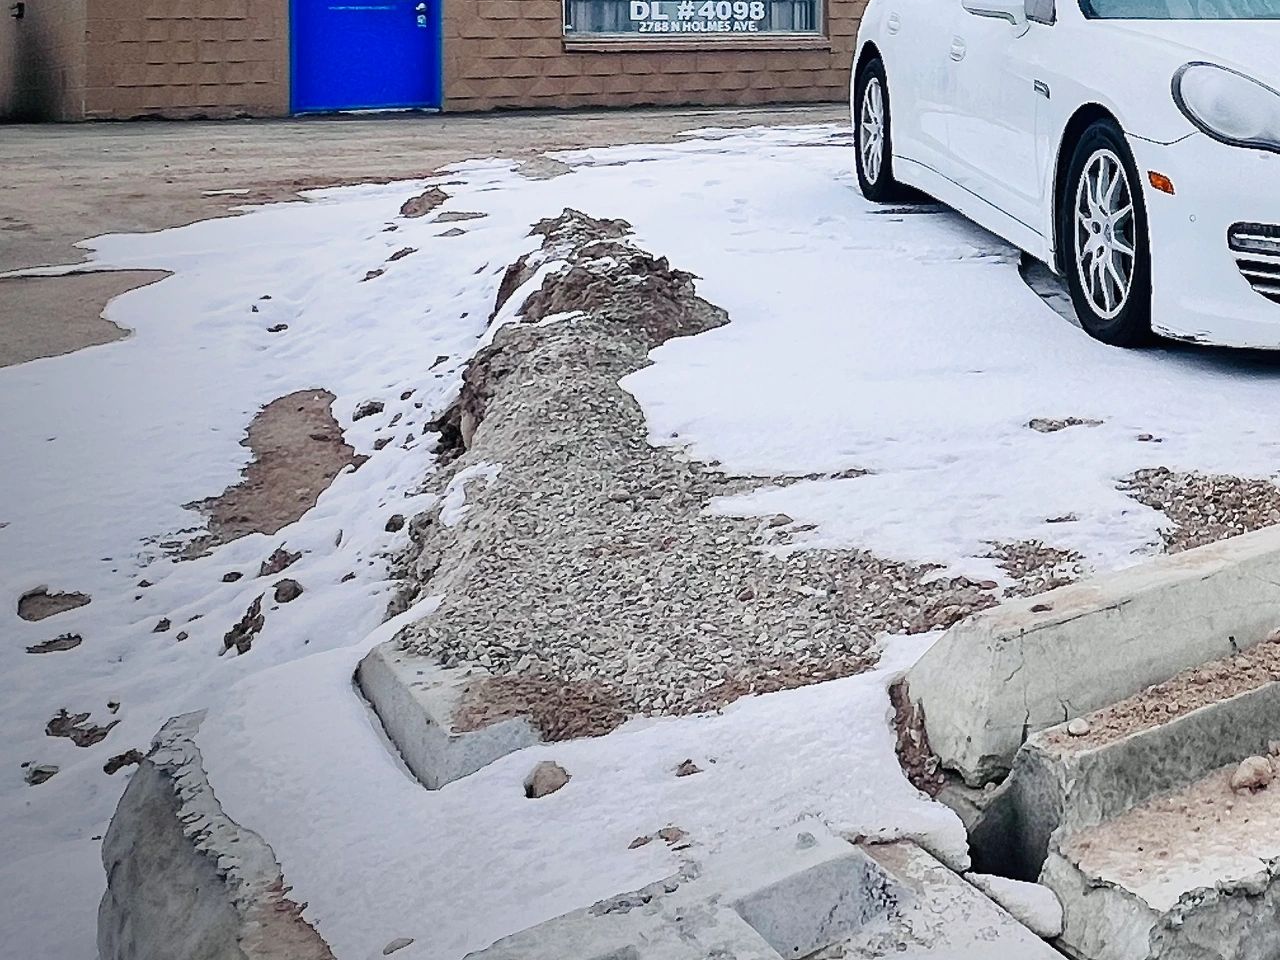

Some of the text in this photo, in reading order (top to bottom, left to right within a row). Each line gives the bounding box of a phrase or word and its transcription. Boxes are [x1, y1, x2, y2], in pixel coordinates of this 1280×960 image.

[630, 0, 765, 20] DL #4098
[639, 21, 758, 32] 2788 N HOLMES AVE.
